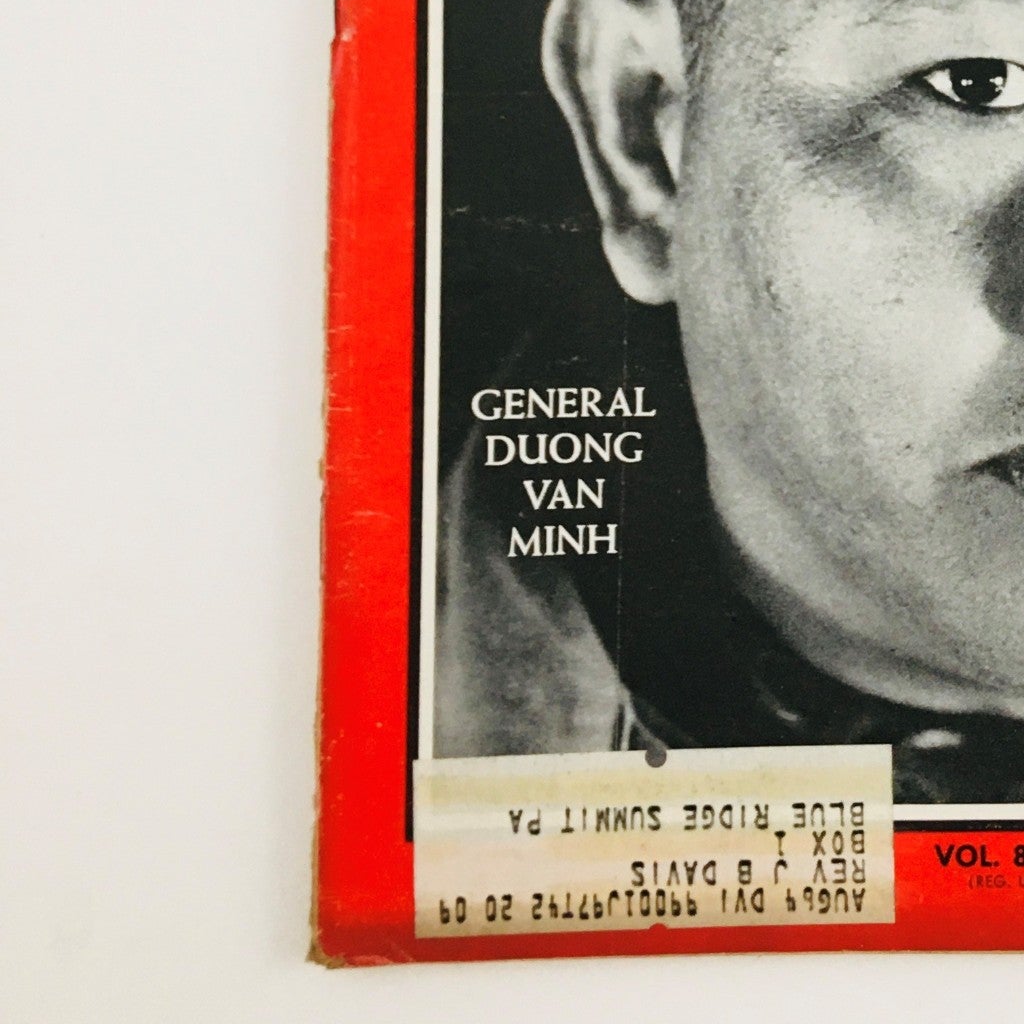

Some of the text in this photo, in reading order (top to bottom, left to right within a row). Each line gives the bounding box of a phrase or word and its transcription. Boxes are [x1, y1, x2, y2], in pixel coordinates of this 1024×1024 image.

[471, 386, 657, 421] GENERAL
[484, 431, 643, 466] DUONG
[523, 478, 606, 510] VAN
[507, 523, 618, 557] MINH
[509, 801, 865, 835] BLUE RIDGE SUMMIT PA
[774, 829, 865, 856] BOX 1
[935, 844, 1000, 868] VOL.
[631, 858, 866, 887] REV J B DAVIS
[968, 874, 1011, 889] (REG.
[439, 895, 466, 924] 09
[485, 893, 513, 922] 20
